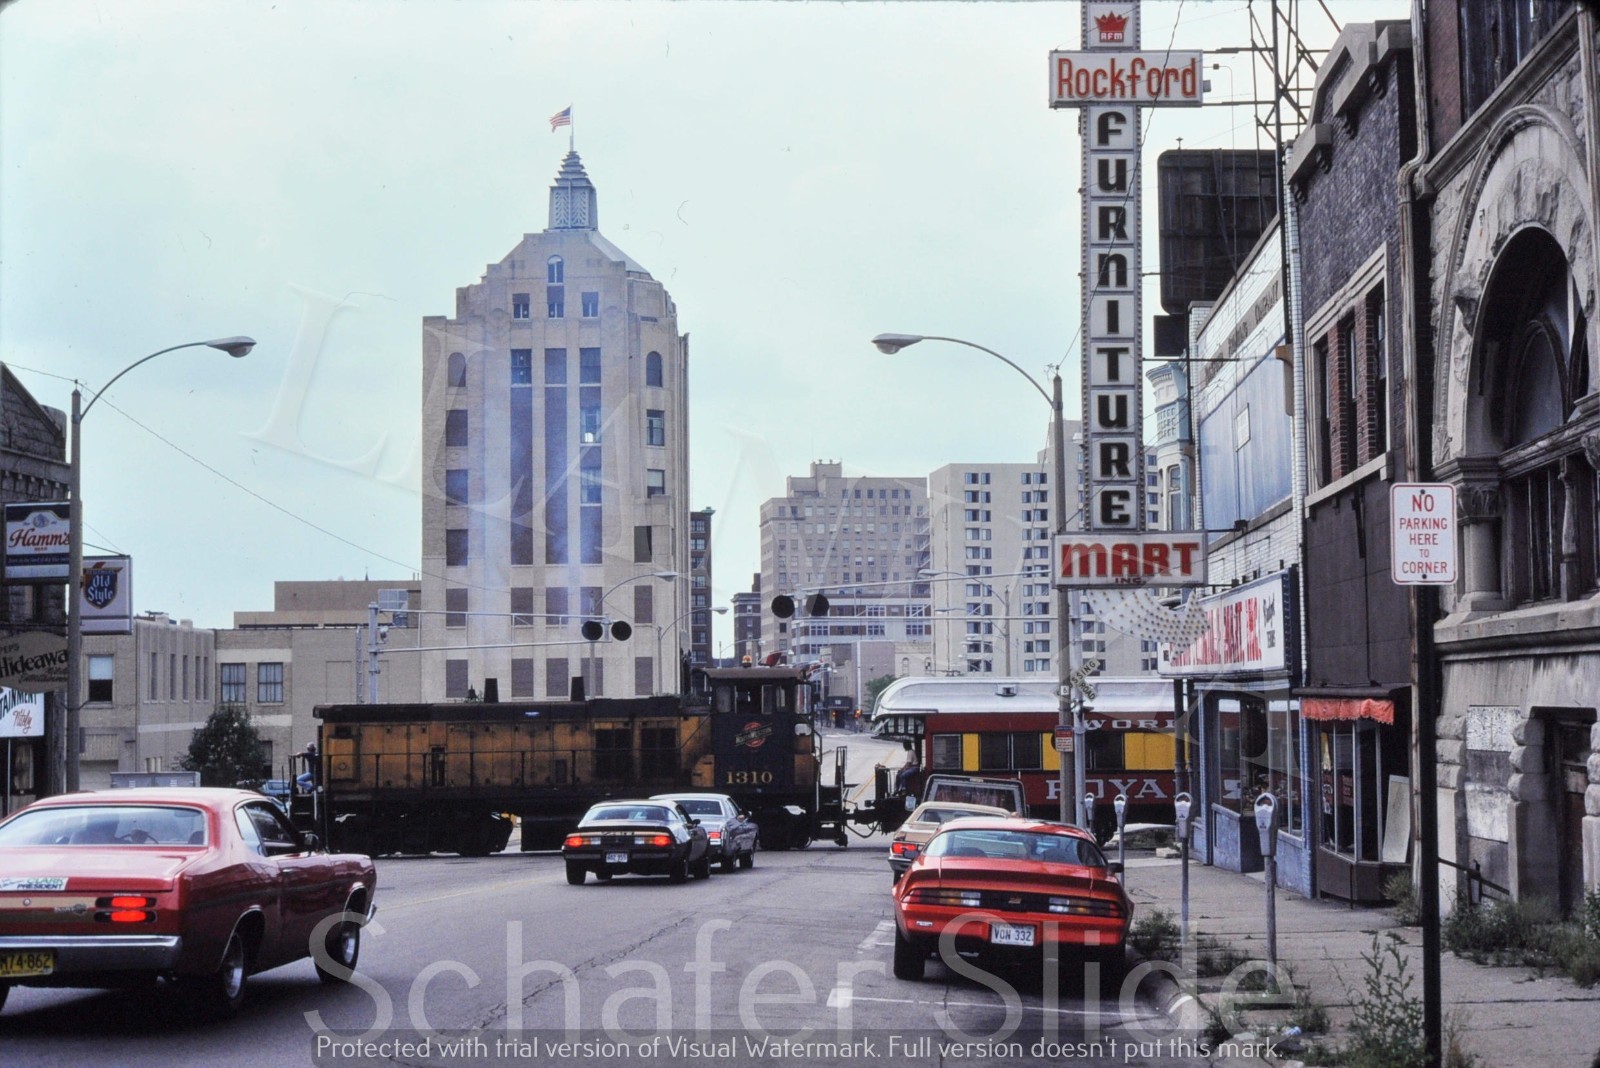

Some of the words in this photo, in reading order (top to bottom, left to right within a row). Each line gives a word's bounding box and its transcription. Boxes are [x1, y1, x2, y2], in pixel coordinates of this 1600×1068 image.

[1057, 57, 1197, 99] Rockford
[1097, 110, 1131, 525] FURNITURE
[1412, 494, 1434, 512] NO
[1399, 517, 1448, 530] PARKING
[8, 528, 70, 548] Hamm's
[1409, 533, 1438, 545] HERE
[1419, 548, 1430, 558] TO
[1061, 542, 1199, 578] MART
[1401, 561, 1448, 574] CORNER
[93, 575, 110, 588] Old
[88, 586, 113, 605] Style
[727, 771, 773, 784] 1310
[1014, 929, 1033, 942] 332
